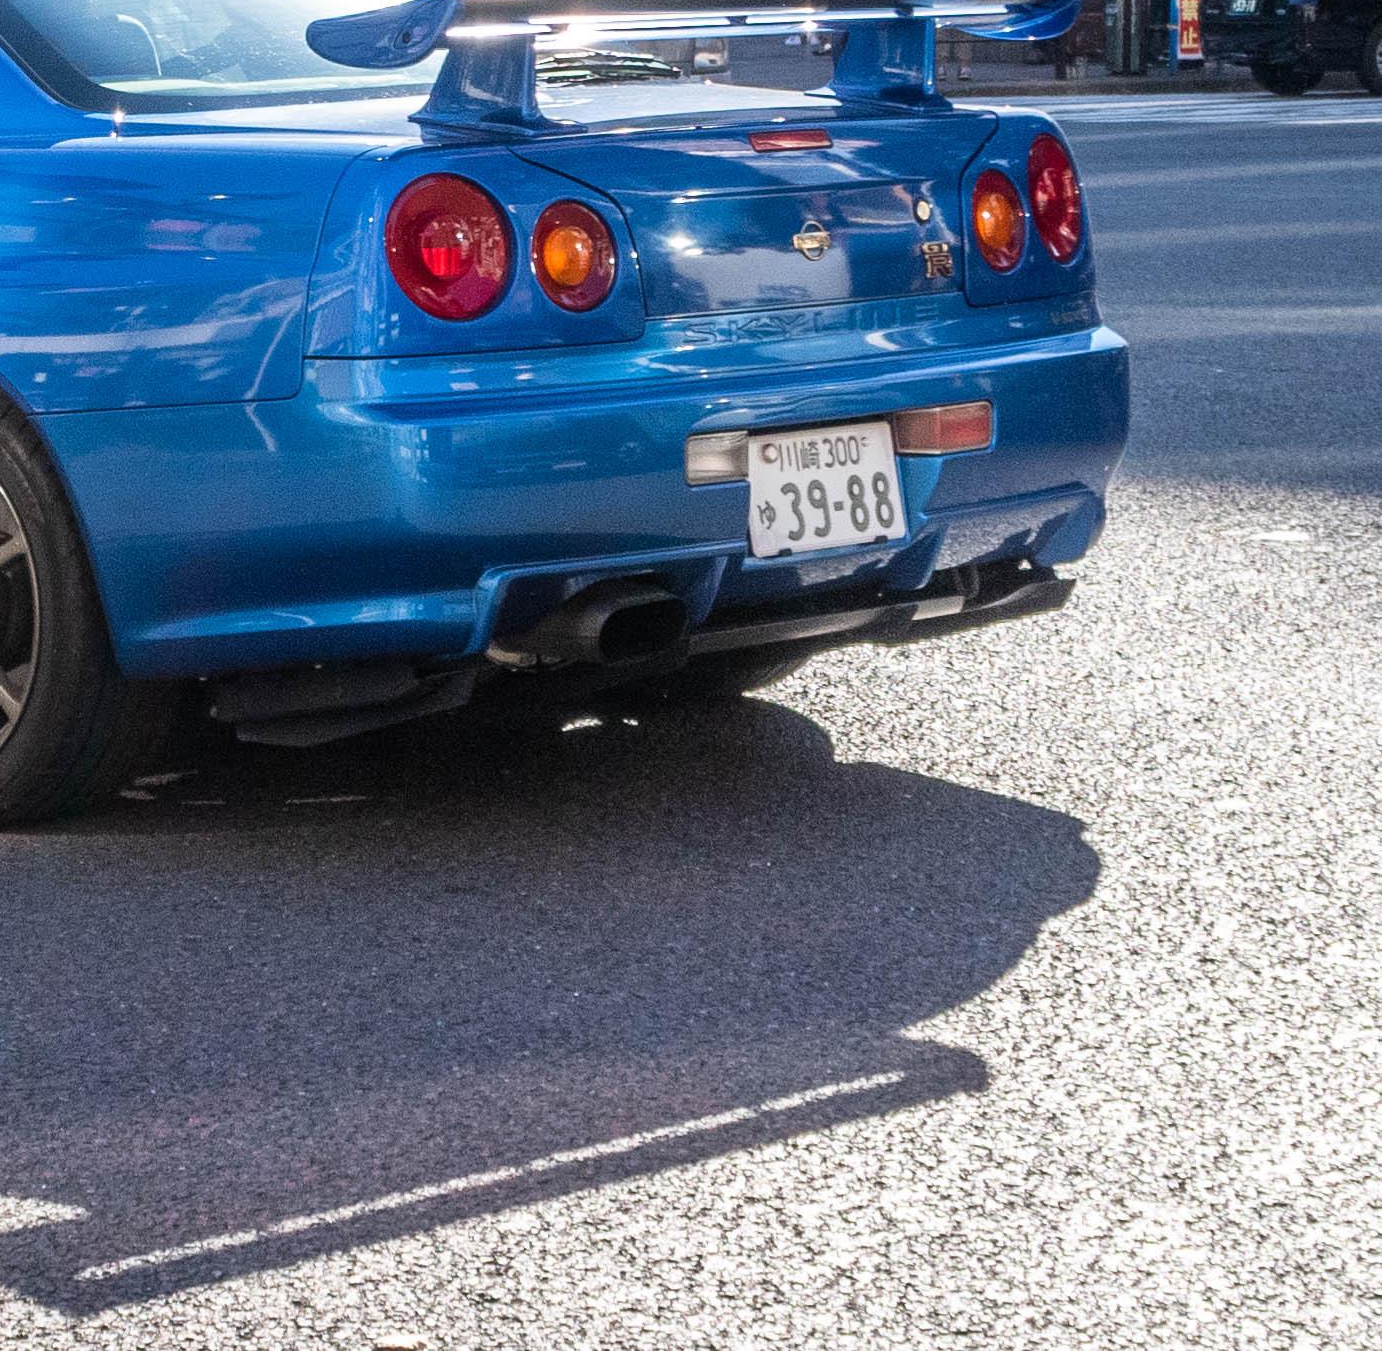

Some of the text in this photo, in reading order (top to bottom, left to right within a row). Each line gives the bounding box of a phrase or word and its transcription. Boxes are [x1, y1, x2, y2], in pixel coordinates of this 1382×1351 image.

[683, 301, 939, 345] SKYLINE
[776, 434, 861, 473] 川崎 300
[757, 471, 896, 542] ゆ 39-88
